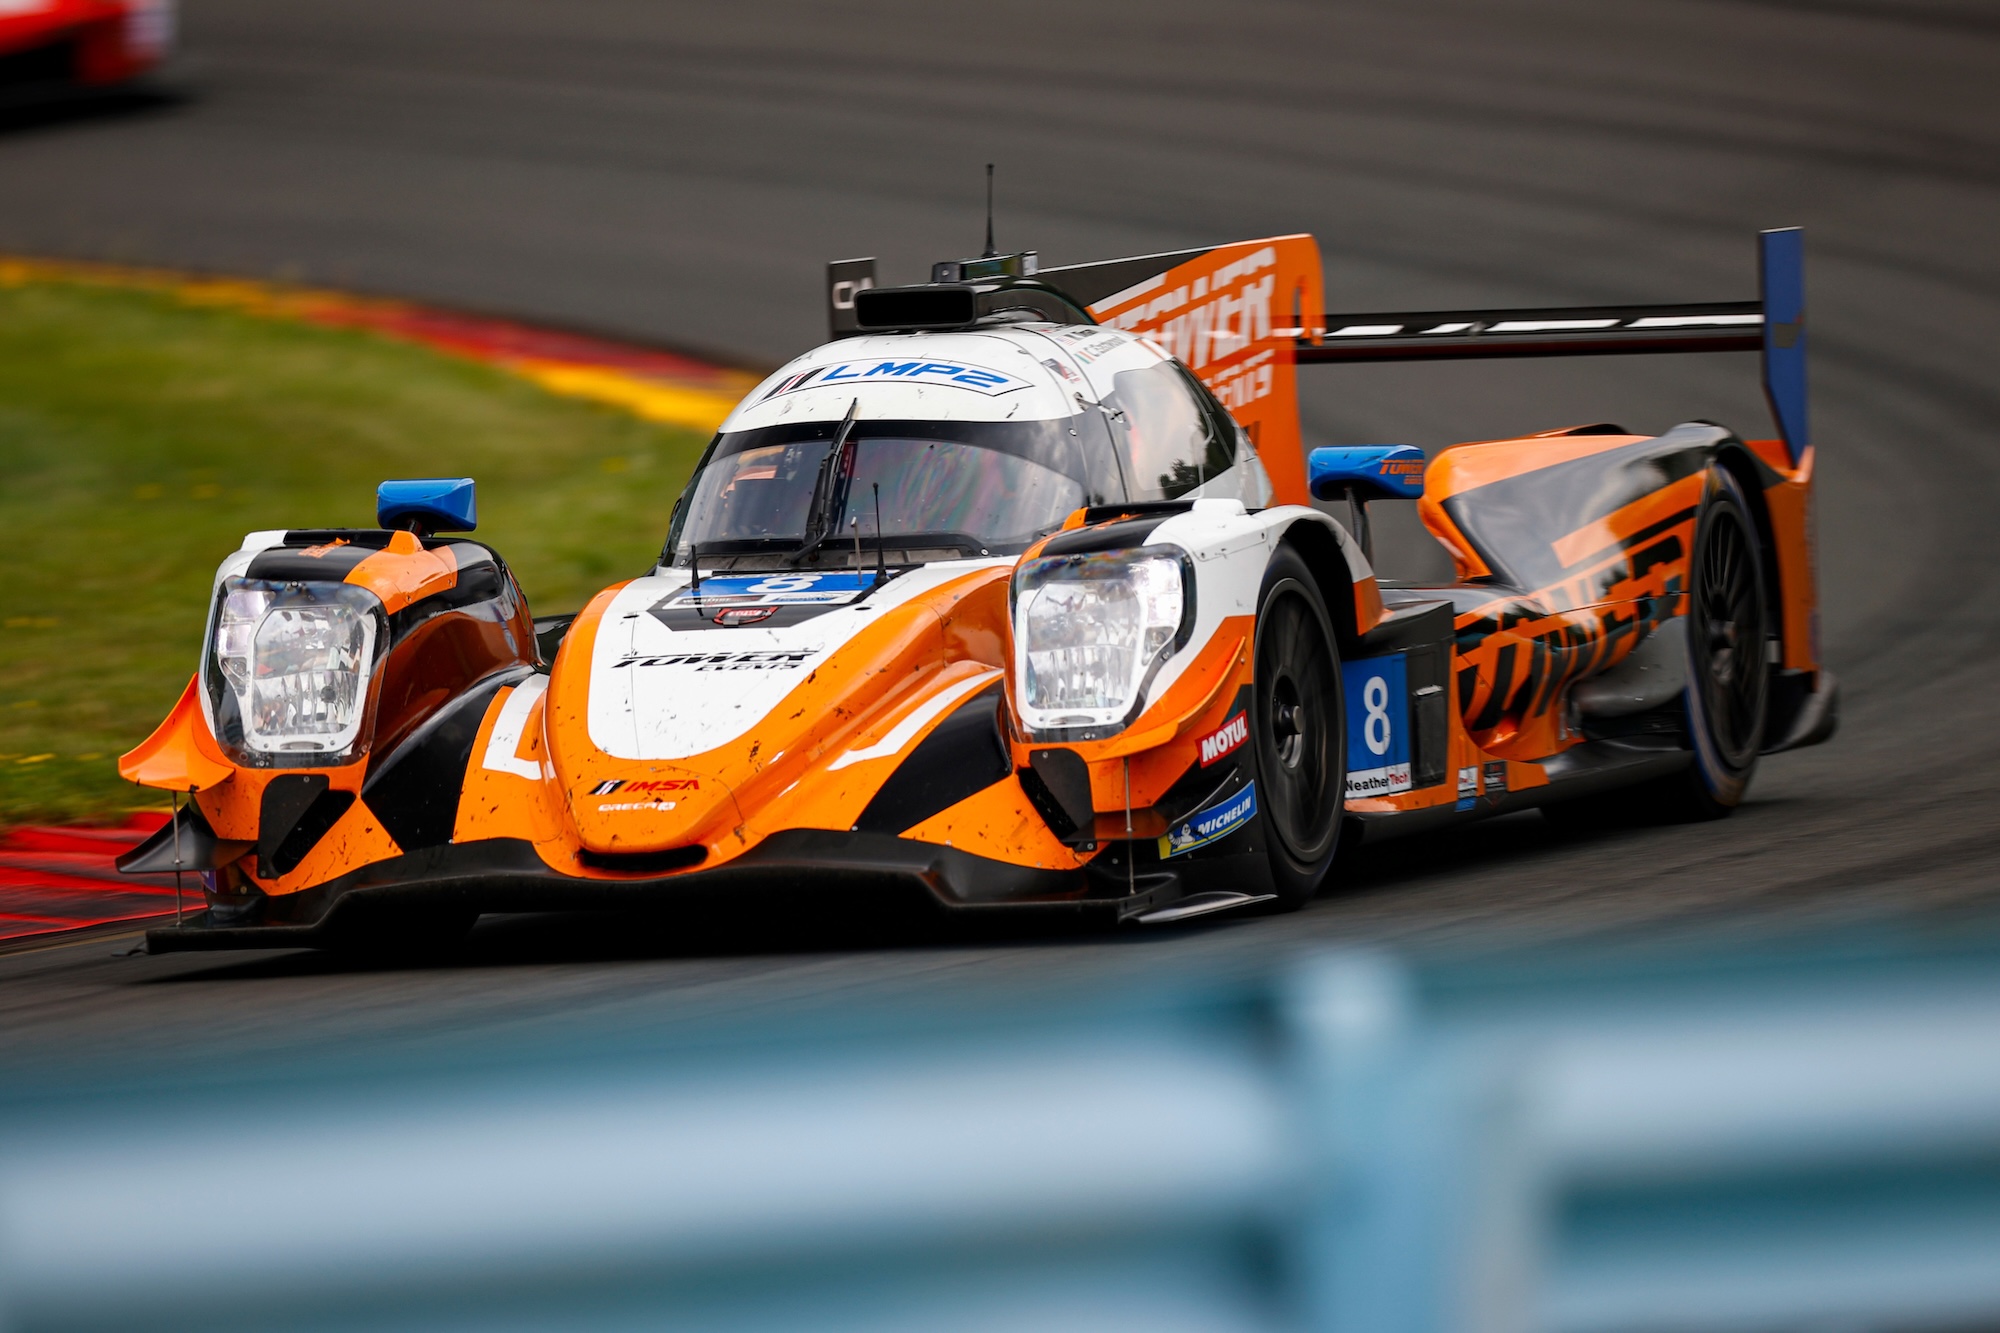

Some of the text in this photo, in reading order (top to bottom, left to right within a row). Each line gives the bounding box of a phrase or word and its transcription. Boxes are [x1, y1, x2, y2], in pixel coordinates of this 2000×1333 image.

[821, 361, 1009, 389] LMP2
[746, 575, 823, 593] 8
[611, 650, 820, 669] TOWER
[695, 662, 804, 672] EVENTS
[1363, 676, 1391, 755] 8
[1201, 716, 1247, 762] MOTUL
[624, 780, 699, 792] IMSA
[1198, 796, 1251, 835] MICHELIN
